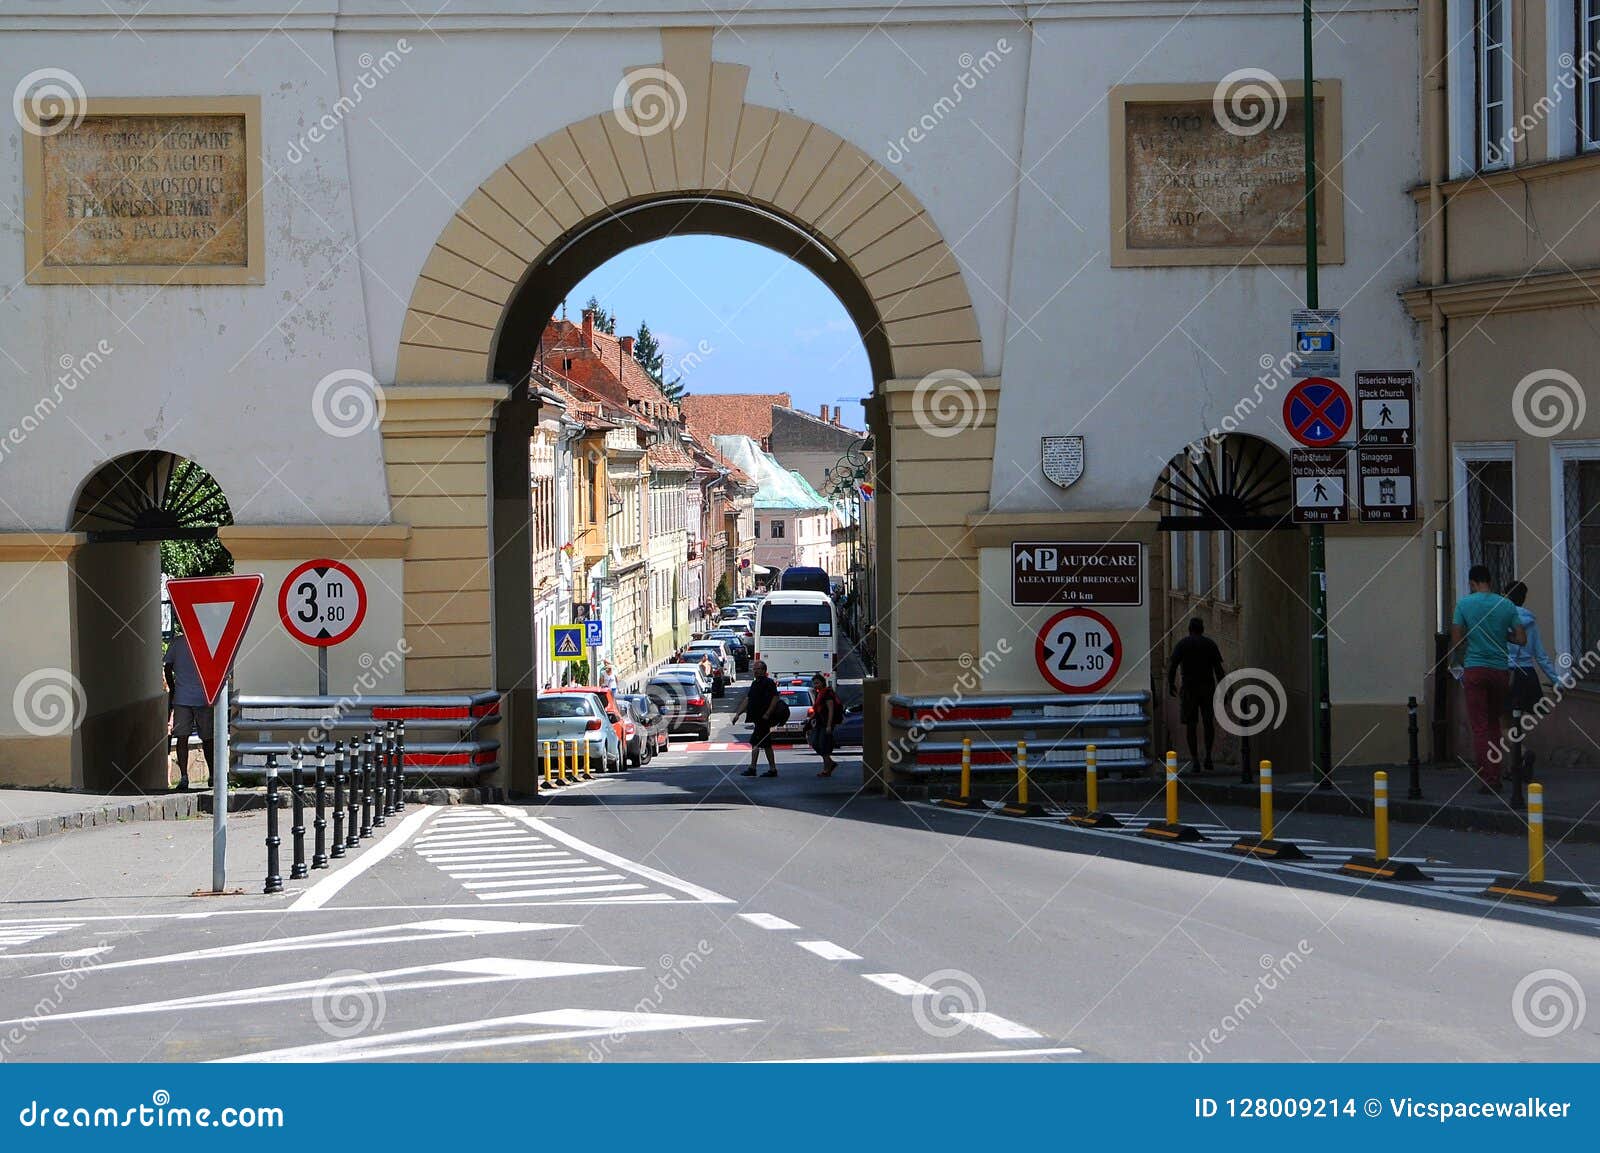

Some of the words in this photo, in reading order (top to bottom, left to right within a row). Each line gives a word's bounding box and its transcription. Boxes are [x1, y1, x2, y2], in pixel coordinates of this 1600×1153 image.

[164, 132, 233, 150] REGIMINE
[164, 154, 223, 172] AUGUSTI
[141, 176, 224, 194] APOSTOLICI
[1358, 376, 1387, 385] Biserica
[1359, 389, 1378, 398] Black
[1380, 389, 1405, 398] Church
[1363, 433, 1378, 442] 400
[1361, 453, 1393, 463] Sinagoga
[1292, 467, 1303, 475] Old
[1303, 467, 1315, 476] City
[1315, 467, 1327, 475] Hall
[1361, 466, 1380, 475] Beith
[1381, 465, 1400, 474] Israel
[1303, 510, 1318, 519] 500
[1368, 510, 1381, 519] 100
[1382, 511, 1391, 519] m
[1039, 550, 1055, 570] P
[1060, 555, 1137, 567] AUTOCARE
[1017, 575, 1045, 584] ALEEA
[1047, 575, 1080, 584] TIBERIU
[1082, 575, 1137, 584] BREDICEANU
[327, 582, 343, 598] m
[1062, 590, 1076, 600] 3.0
[1079, 590, 1094, 600] km
[1085, 632, 1101, 648] m
